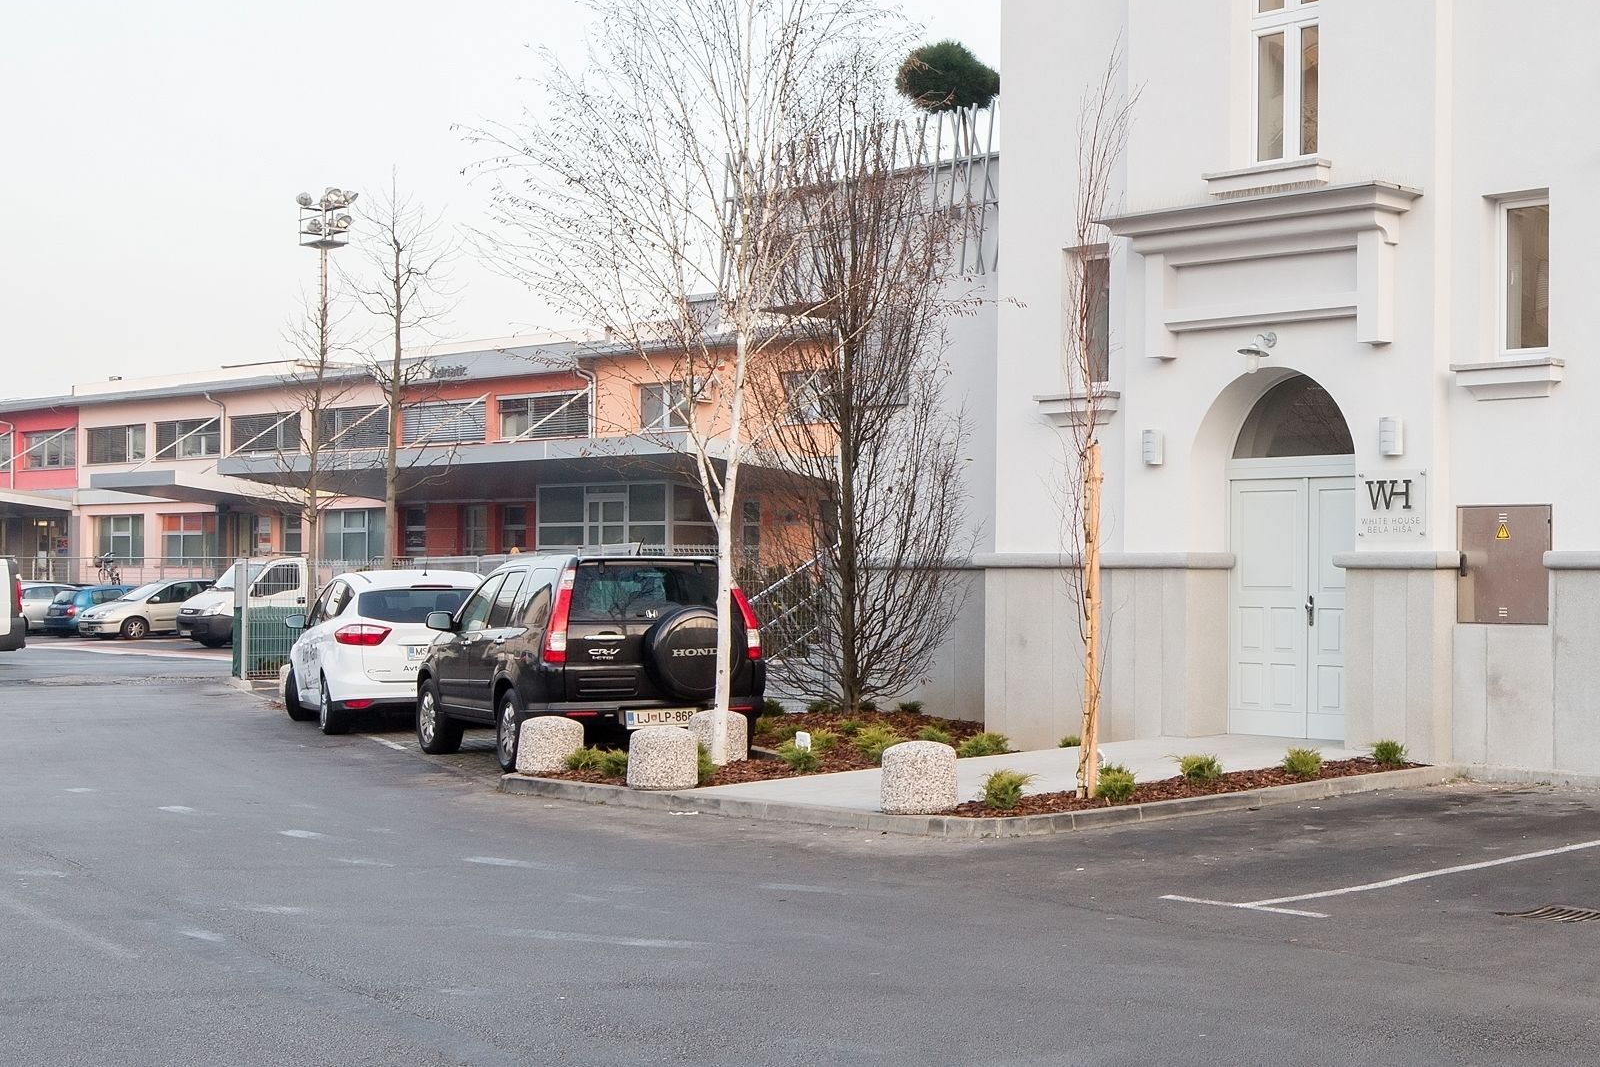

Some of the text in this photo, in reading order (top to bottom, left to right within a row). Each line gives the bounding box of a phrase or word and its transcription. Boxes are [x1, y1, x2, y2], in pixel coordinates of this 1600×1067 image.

[1365, 479, 1412, 510] WH
[1361, 516, 1420, 525] WHITE HOUSE
[1367, 524, 1412, 534] BELA HIŠA
[671, 647, 718, 657] HOND
[637, 713, 650, 724] LJ
